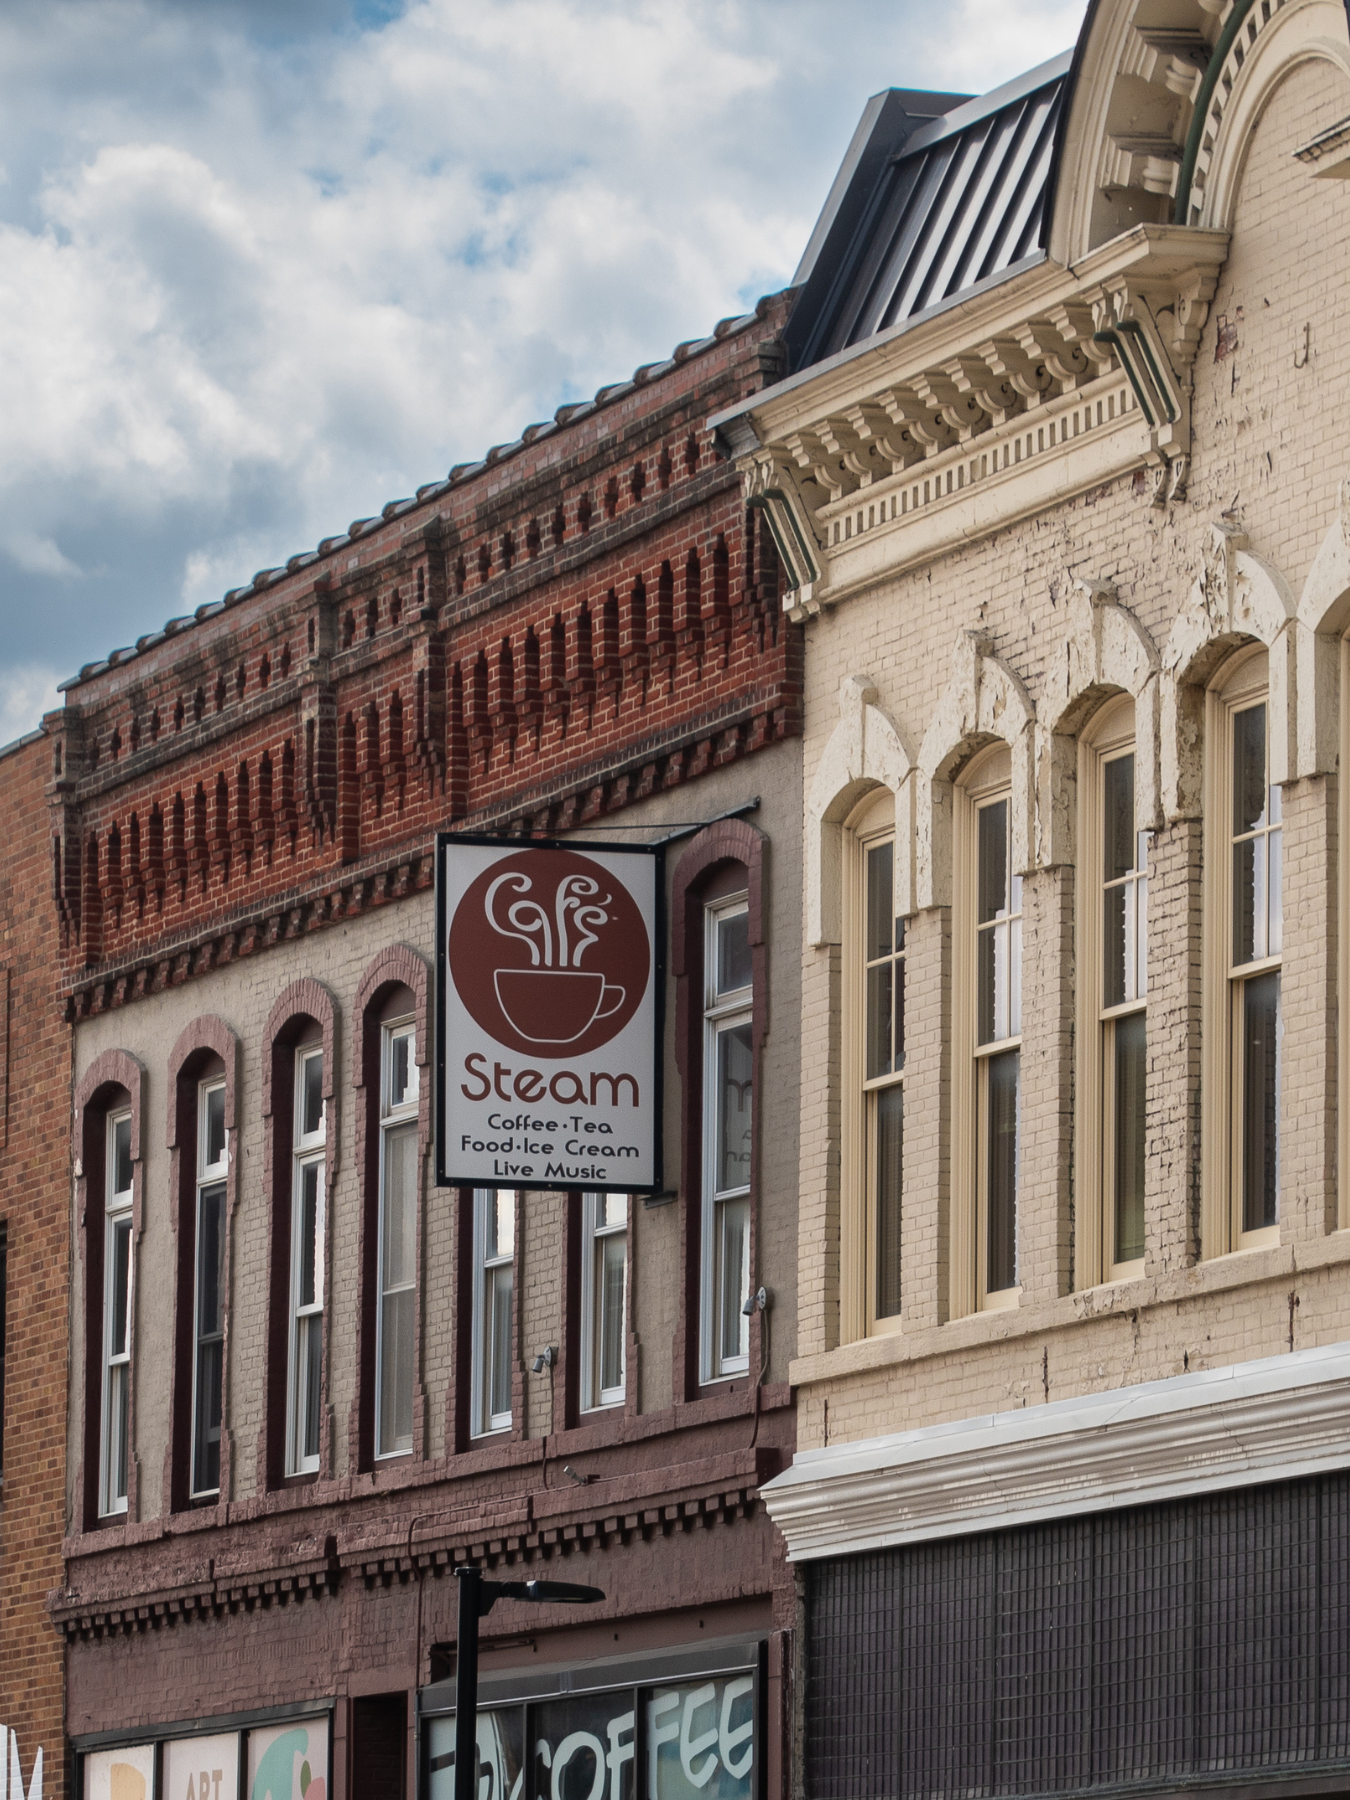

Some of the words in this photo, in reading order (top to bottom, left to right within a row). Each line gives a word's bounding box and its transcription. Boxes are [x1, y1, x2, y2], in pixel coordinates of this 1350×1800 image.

[461, 1052, 640, 1108] Steam
[565, 1139, 640, 1157] Cream
[494, 1159, 534, 1177] Live
[544, 1161, 607, 1179] Music
